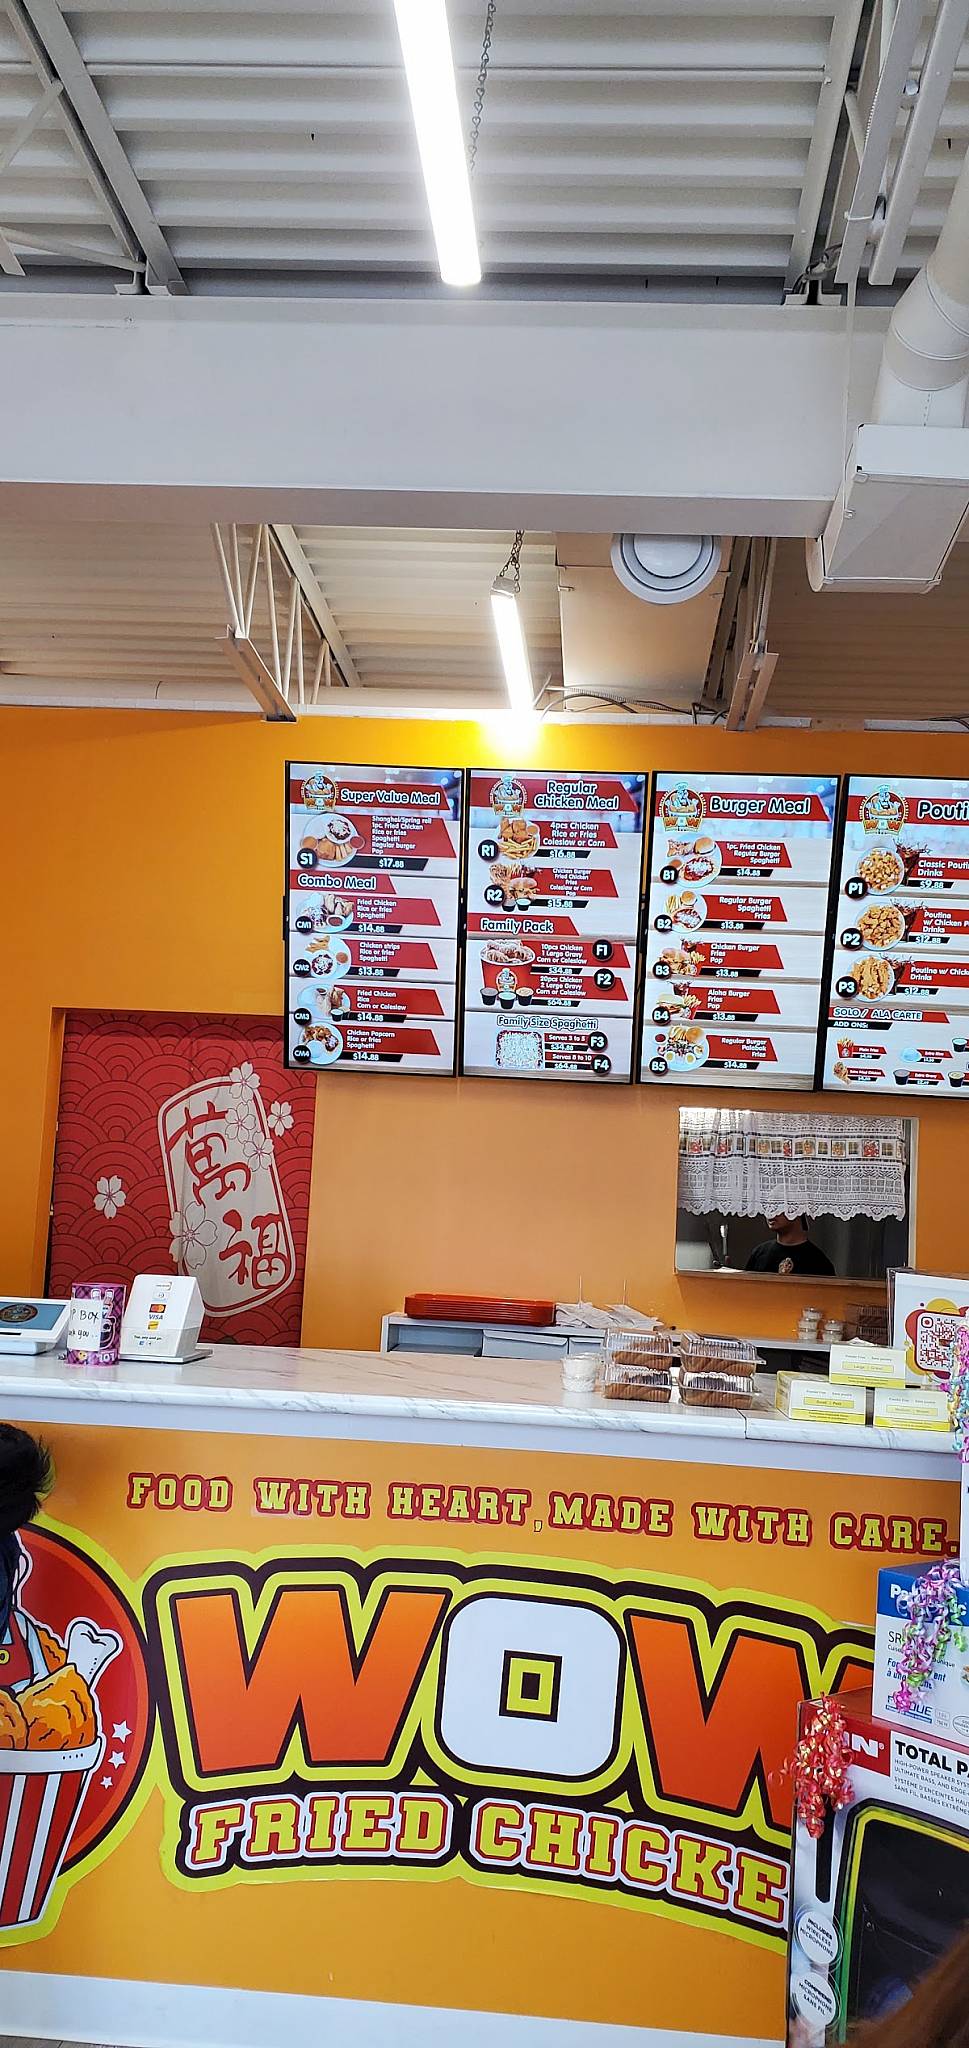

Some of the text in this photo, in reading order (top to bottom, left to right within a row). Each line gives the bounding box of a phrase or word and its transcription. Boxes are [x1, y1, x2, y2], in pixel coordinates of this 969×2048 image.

[547, 781, 597, 795] Regular
[341, 789, 440, 805] Super Value Meal
[534, 796, 619, 810] Chicken Meal
[709, 796, 765, 816] Burger
[768, 798, 810, 814] Meal
[570, 823, 599, 831] Chicken
[482, 845, 494, 856] R1
[550, 851, 575, 859] $16.88
[300, 853, 312, 865] S1
[379, 858, 404, 868] $17.88
[750, 857, 780, 865] Spaghetti
[918, 860, 945, 868] Classic
[663, 870, 675, 880] B1
[737, 869, 760, 877] $14.88
[298, 874, 376, 889] Combo Meal
[920, 880, 944, 889] $9.88
[849, 883, 862, 894] P1
[487, 889, 503, 901] R2
[548, 900, 573, 908] $15.88
[738, 904, 771, 912] Spaghetti
[755, 912, 770, 920] Fries
[296, 921, 311, 929] CM1
[358, 924, 384, 933] $14.88
[480, 917, 554, 935] Family Pack
[657, 919, 671, 928] B2
[721, 921, 744, 930] $13.88
[843, 934, 860, 945] P2
[916, 936, 941, 944] $12.88
[596, 945, 608, 956] F1
[358, 968, 383, 976] $13.88
[655, 965, 669, 975] B3
[716, 970, 738, 978] $13.88
[911, 967, 937, 975] Poutine
[596, 974, 611, 985] F2
[838, 982, 854, 992] P3
[905, 988, 930, 996] $12.88
[728, 990, 750, 998] Burger
[357, 1013, 383, 1021] $14.88
[653, 1011, 669, 1021] B4
[712, 1013, 735, 1021] $13.88
[871, 1009, 891, 1019] ALA
[892, 1010, 922, 1020] CARTE
[497, 1016, 598, 1031] Family Size Spaghetti
[590, 1036, 605, 1047] F3
[353, 1052, 379, 1060] $14.88
[594, 1059, 609, 1070] F4
[651, 1061, 665, 1071] B5
[724, 1061, 747, 1069] $14.88
[128, 1472, 233, 1513] FOOD
[253, 1477, 372, 1519] WITH
[548, 1490, 674, 1536] MADE
[691, 1502, 813, 1547] WITH
[830, 1511, 959, 1556] CARE.
[170, 1583, 873, 1828] WOW
[895, 1740, 952, 1772] TOTAL
[957, 1760, 969, 1778] P
[895, 1767, 919, 1779] ULTIMATE
[937, 1782, 949, 1790] AND
[930, 1771, 955, 1783] SPEAKER
[894, 1784, 908, 1793] SANS
[920, 1793, 940, 1804] BASSES
[188, 1791, 790, 1928] FRIED CHICKE
[808, 1918, 832, 1940] INCLUDES
[806, 1924, 832, 1947] WIRELESS
[800, 1927, 834, 1957] MICROPHONE
[799, 1983, 832, 2013] MICROPHONE
[803, 1994, 817, 2009] SANS
